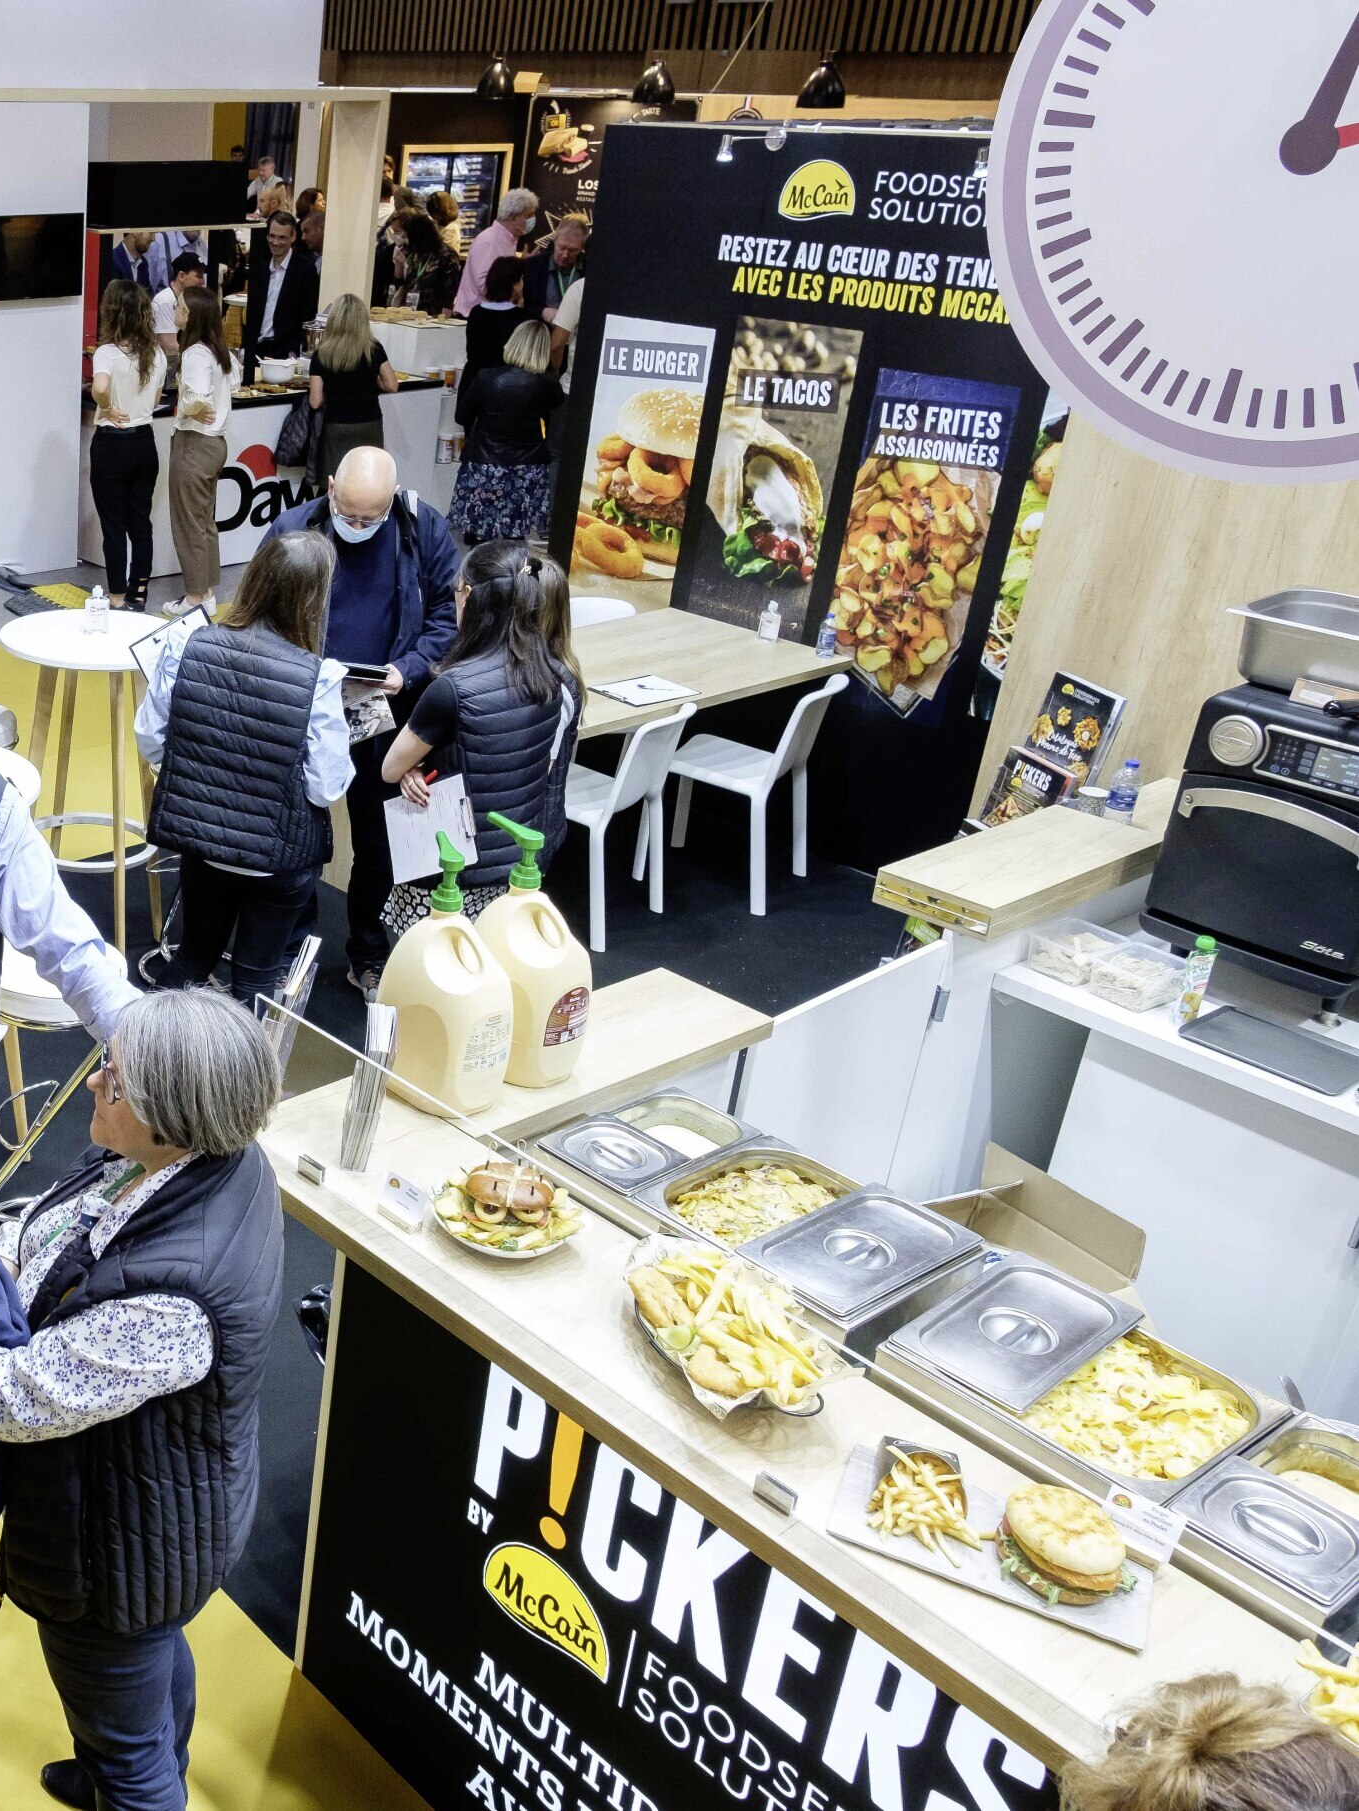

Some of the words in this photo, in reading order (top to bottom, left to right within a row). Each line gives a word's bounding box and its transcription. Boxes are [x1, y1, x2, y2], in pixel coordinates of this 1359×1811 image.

[785, 182, 849, 210] McCain
[868, 197, 987, 228] SOLUTIO
[718, 234, 791, 267] RESTEZ
[793, 241, 824, 271] AU
[827, 245, 891, 278] CŒUR
[894, 251, 940, 283] DES
[731, 266, 783, 297] AVEC
[786, 272, 825, 302] LES
[828, 276, 936, 316] PRODUITS
[939, 288, 1011, 325] MCCA
[608, 346, 630, 371] LE
[632, 348, 700, 377] BURGER
[743, 376, 767, 402] LE
[772, 378, 833, 407] TACOS
[879, 402, 920, 431] LES
[923, 406, 1002, 440] FRITES
[874, 434, 1000, 468] ASSAISONNÉES
[1047, 730, 1079, 750] Catalogue
[467, 1498, 494, 1534] BY
[494, 1562, 599, 1665] McCain
[346, 1591, 565, 1811] MOMENTS
[643, 1651, 845, 1811] FOODSE
